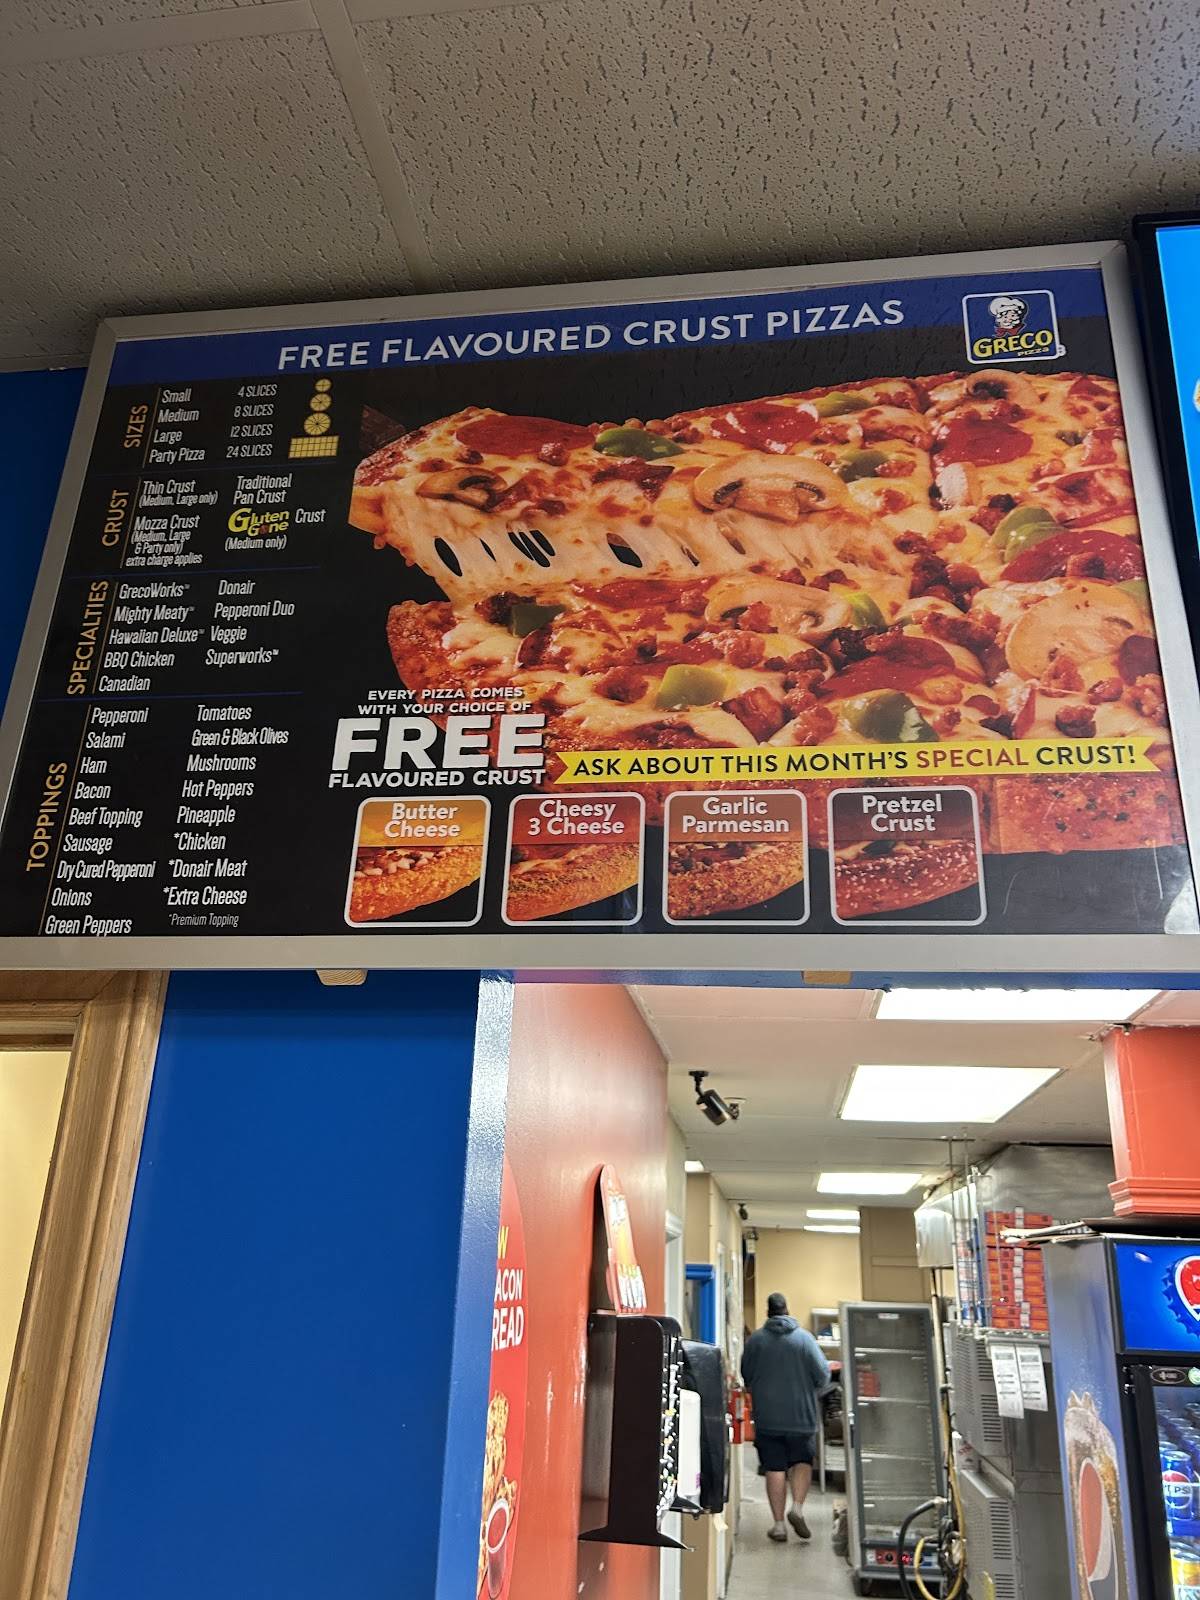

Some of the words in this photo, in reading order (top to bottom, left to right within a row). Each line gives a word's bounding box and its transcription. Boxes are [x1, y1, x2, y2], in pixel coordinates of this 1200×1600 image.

[278, 341, 370, 370] FREE
[381, 323, 611, 363] FLAVOURED
[623, 313, 754, 346] CRUST
[766, 299, 905, 336] PIZZAS
[973, 330, 1053, 358] GRECO
[162, 388, 192, 403] Small
[238, 386, 245, 397] 4
[246, 384, 277, 397] SLICES
[158, 408, 199, 423] Medium
[234, 406, 241, 417] 8
[242, 404, 274, 417] SLICES
[124, 405, 148, 449] SIZES
[230, 426, 239, 438] 12
[241, 424, 273, 437] SLICES
[154, 430, 183, 445] Large
[149, 450, 177, 465] Party
[178, 447, 205, 461] Pizza
[226, 446, 239, 458] 24
[241, 444, 273, 457] SLICES
[143, 481, 164, 495] Thin
[167, 480, 196, 493] Crust
[237, 474, 292, 490] Traditional
[177, 492, 197, 505] Large
[199, 491, 218, 504] only)
[233, 490, 254, 505] Pan
[256, 490, 286, 503] Crust
[102, 490, 129, 546] CRUST
[134, 516, 167, 531] Mozza
[170, 514, 200, 528] Crust
[228, 508, 289, 533] Gluten
[295, 508, 326, 524] Crust
[170, 530, 190, 542] Large
[225, 538, 263, 551] (Medium
[265, 535, 287, 550] only)
[143, 543, 162, 555] Party
[163, 541, 183, 554] only)
[126, 556, 145, 567] extra
[147, 554, 173, 567] charge
[174, 553, 203, 566] applies
[218, 580, 255, 595] Donair
[114, 606, 151, 624] Mighty
[214, 602, 270, 620] Pepperoni
[272, 601, 295, 616] Duo
[67, 580, 109, 695] SPECIALTIES
[109, 629, 158, 644] Hawaiian
[210, 626, 247, 644] Veggie
[104, 652, 129, 669] BBQ
[130, 651, 175, 667] Chicken
[99, 675, 150, 692] Canadian
[368, 690, 416, 700] EVERY
[422, 688, 465, 699] PIZZA
[471, 687, 523, 698] COMES
[91, 708, 149, 726] Pepperoni
[197, 705, 252, 721] Tomatoes
[358, 704, 399, 715] WITH
[403, 702, 444, 714] YOUR
[449, 701, 506, 713] CHOICE
[511, 701, 531, 711] OF
[86, 732, 126, 748] Salami
[192, 729, 219, 746] Green
[221, 729, 230, 745] &
[231, 728, 260, 745] Black
[259, 727, 289, 744] Olives
[331, 713, 546, 771] FREE
[80, 757, 107, 774] Ham
[186, 755, 256, 772] Mushrooms
[573, 758, 622, 776] ASK
[627, 756, 718, 775] ABOUT
[721, 754, 779, 773] THIS
[915, 748, 1030, 770] SPECIAL
[1035, 745, 1136, 767] CRUST!
[328, 771, 465, 788] FLAVOURED
[473, 769, 546, 785] CRUST
[75, 782, 111, 799] Bacon
[182, 780, 204, 797] Hot
[205, 779, 254, 799] Peppers
[392, 803, 458, 820] Butter
[539, 800, 616, 821] Cheesy
[703, 796, 768, 816] Garlic
[862, 794, 943, 814] Pretzel
[26, 762, 67, 872] TOPPINGS
[69, 808, 98, 825] Beef
[99, 807, 143, 828] Topping
[177, 805, 236, 826] Pineapple
[870, 813, 936, 833] Crust
[384, 820, 461, 839] Cheese
[528, 818, 541, 835] 3
[547, 817, 625, 835] Cheese
[681, 815, 790, 835] Parmesan
[63, 834, 113, 855] Sausage
[57, 861, 74, 882] Dry
[75, 861, 104, 878] Cured
[105, 860, 156, 881] Pepperoni
[214, 859, 248, 877] Meat
[51, 888, 92, 906] Onions
[202, 886, 247, 905] Cheese
[45, 915, 80, 934] Green
[82, 916, 132, 937] Peppers
[208, 913, 239, 927] Topping
[491, 1306, 524, 1351] READ
